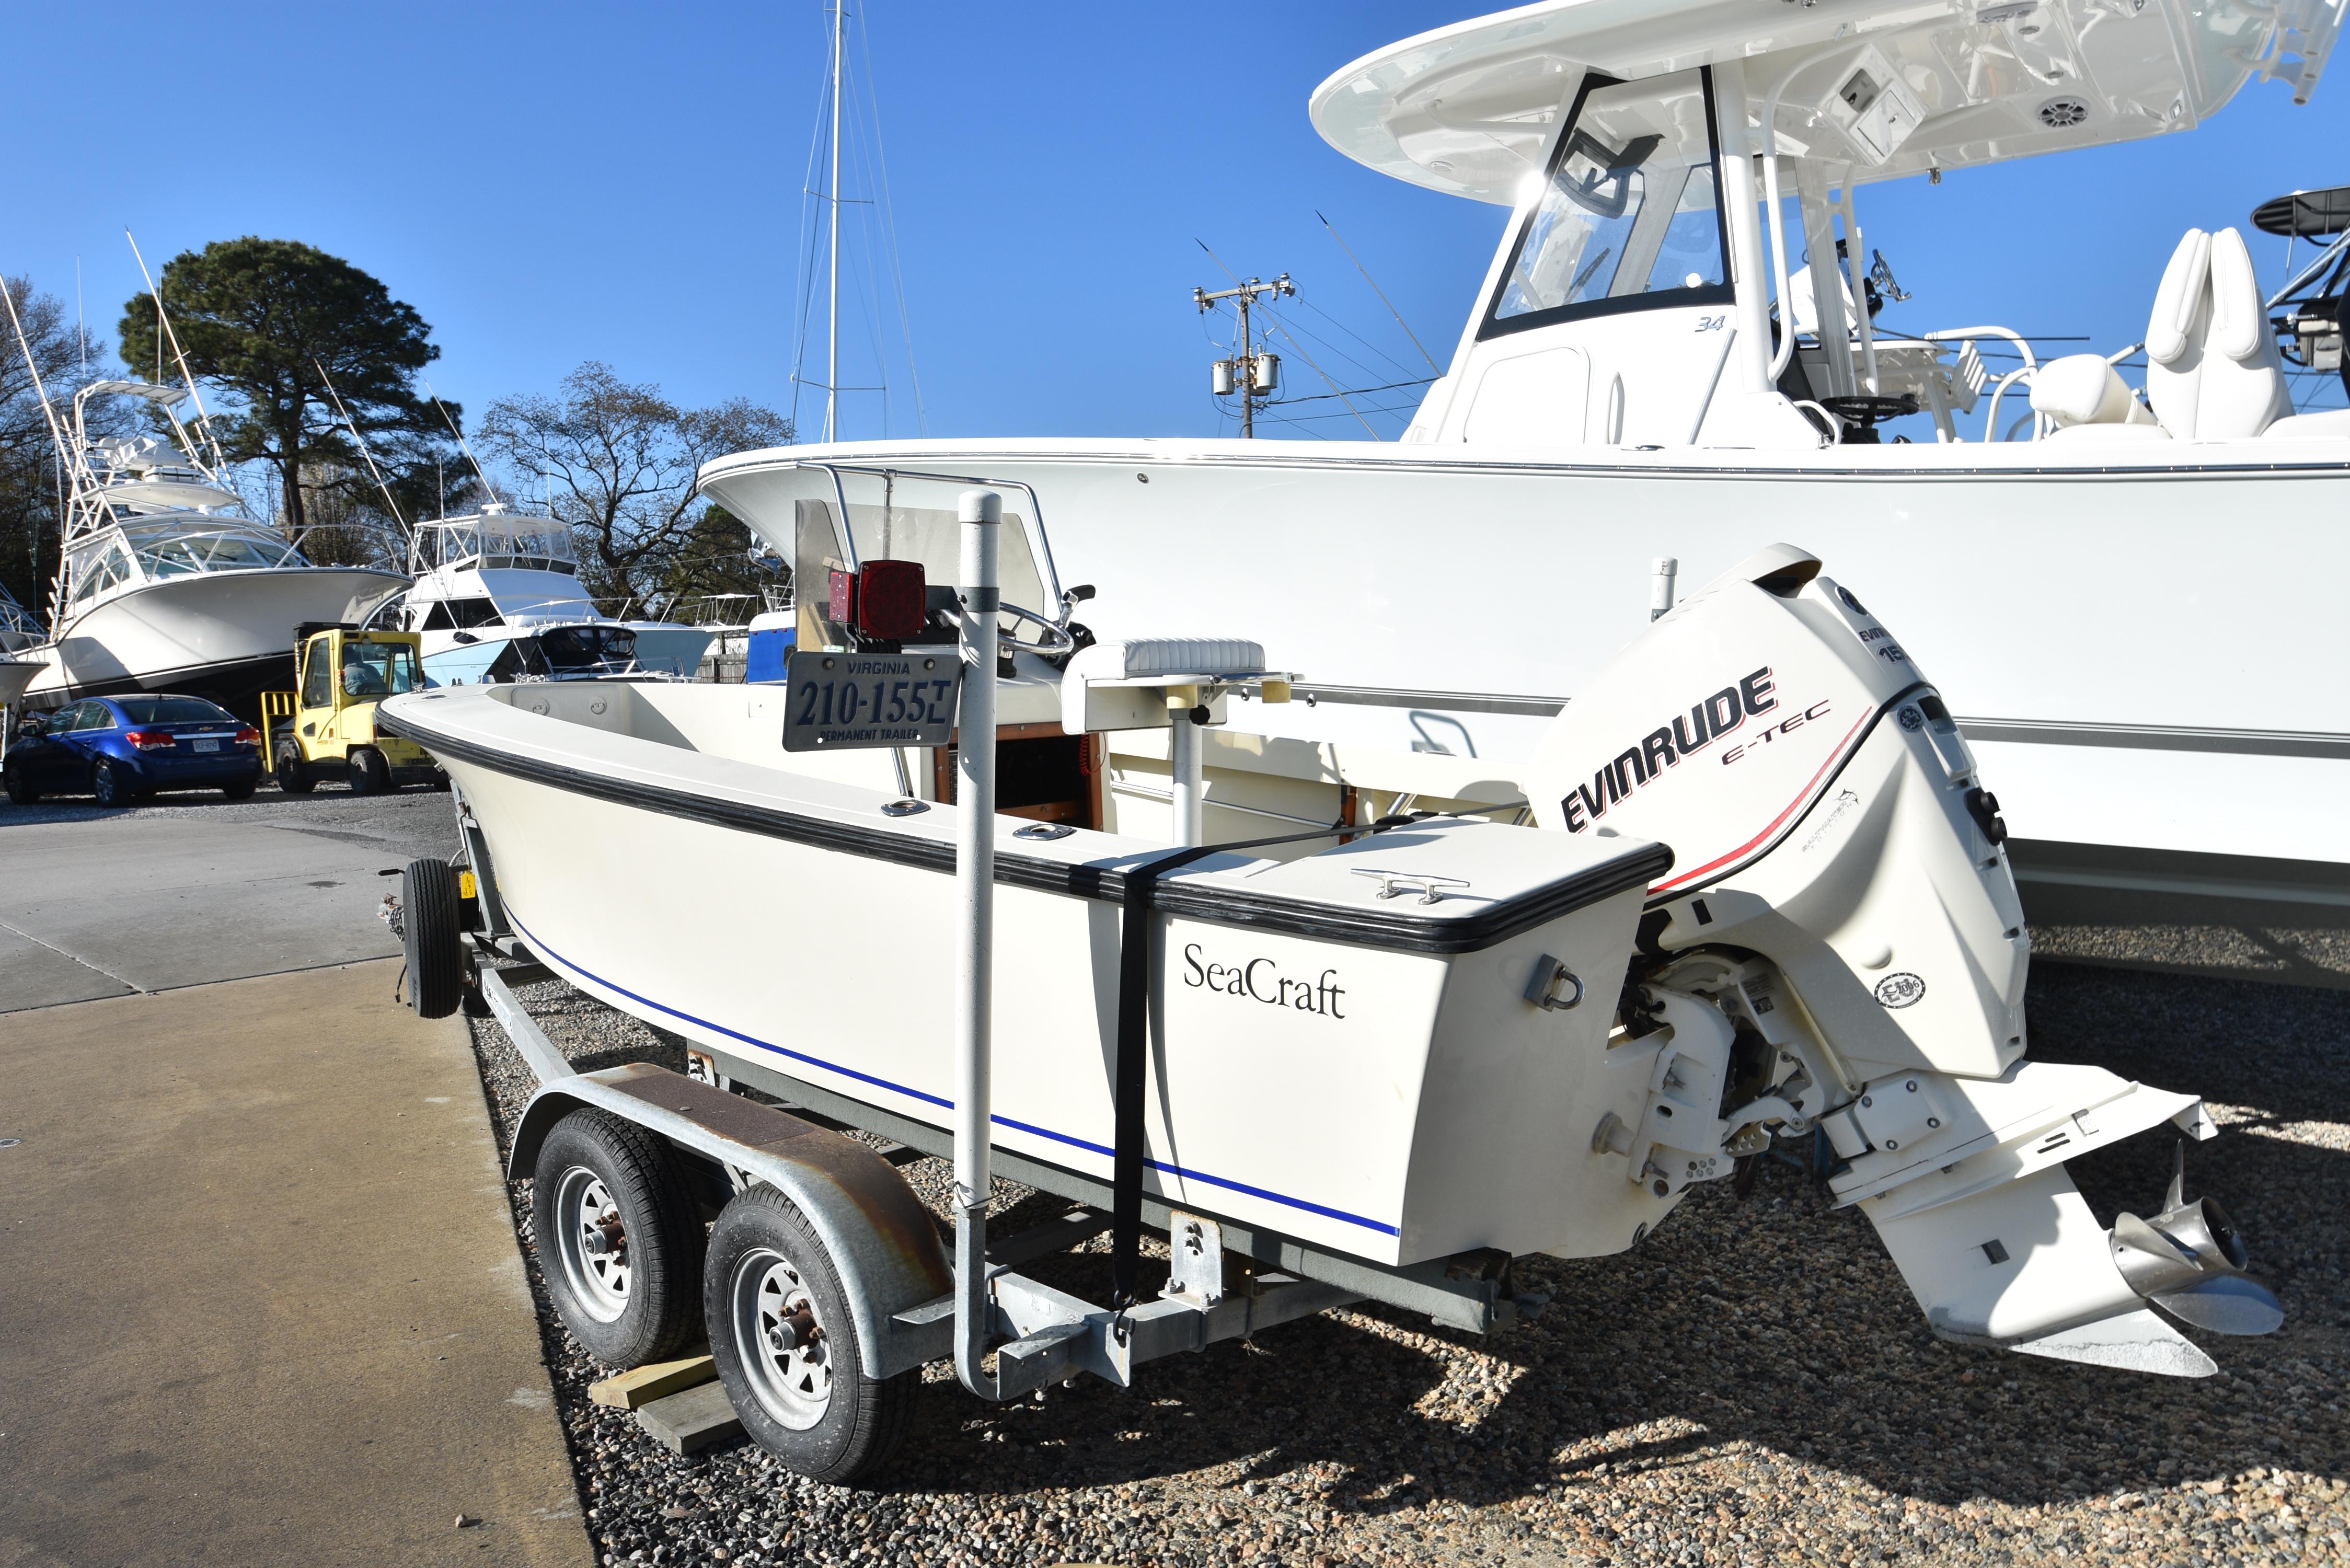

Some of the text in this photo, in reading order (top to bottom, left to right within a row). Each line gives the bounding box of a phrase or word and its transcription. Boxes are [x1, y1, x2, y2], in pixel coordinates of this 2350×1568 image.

[1695, 315, 1725, 332] 34
[1858, 628, 1888, 642] EVIN
[1878, 645, 1907, 663] 15
[848, 662, 911, 675] VIRGINIA
[819, 729, 919, 742] PERMANENT TRAILER
[1722, 699, 1831, 766] E-TEC
[1561, 666, 1778, 834] EVINRUDE
[1184, 943, 1345, 1019] SeaCraft
